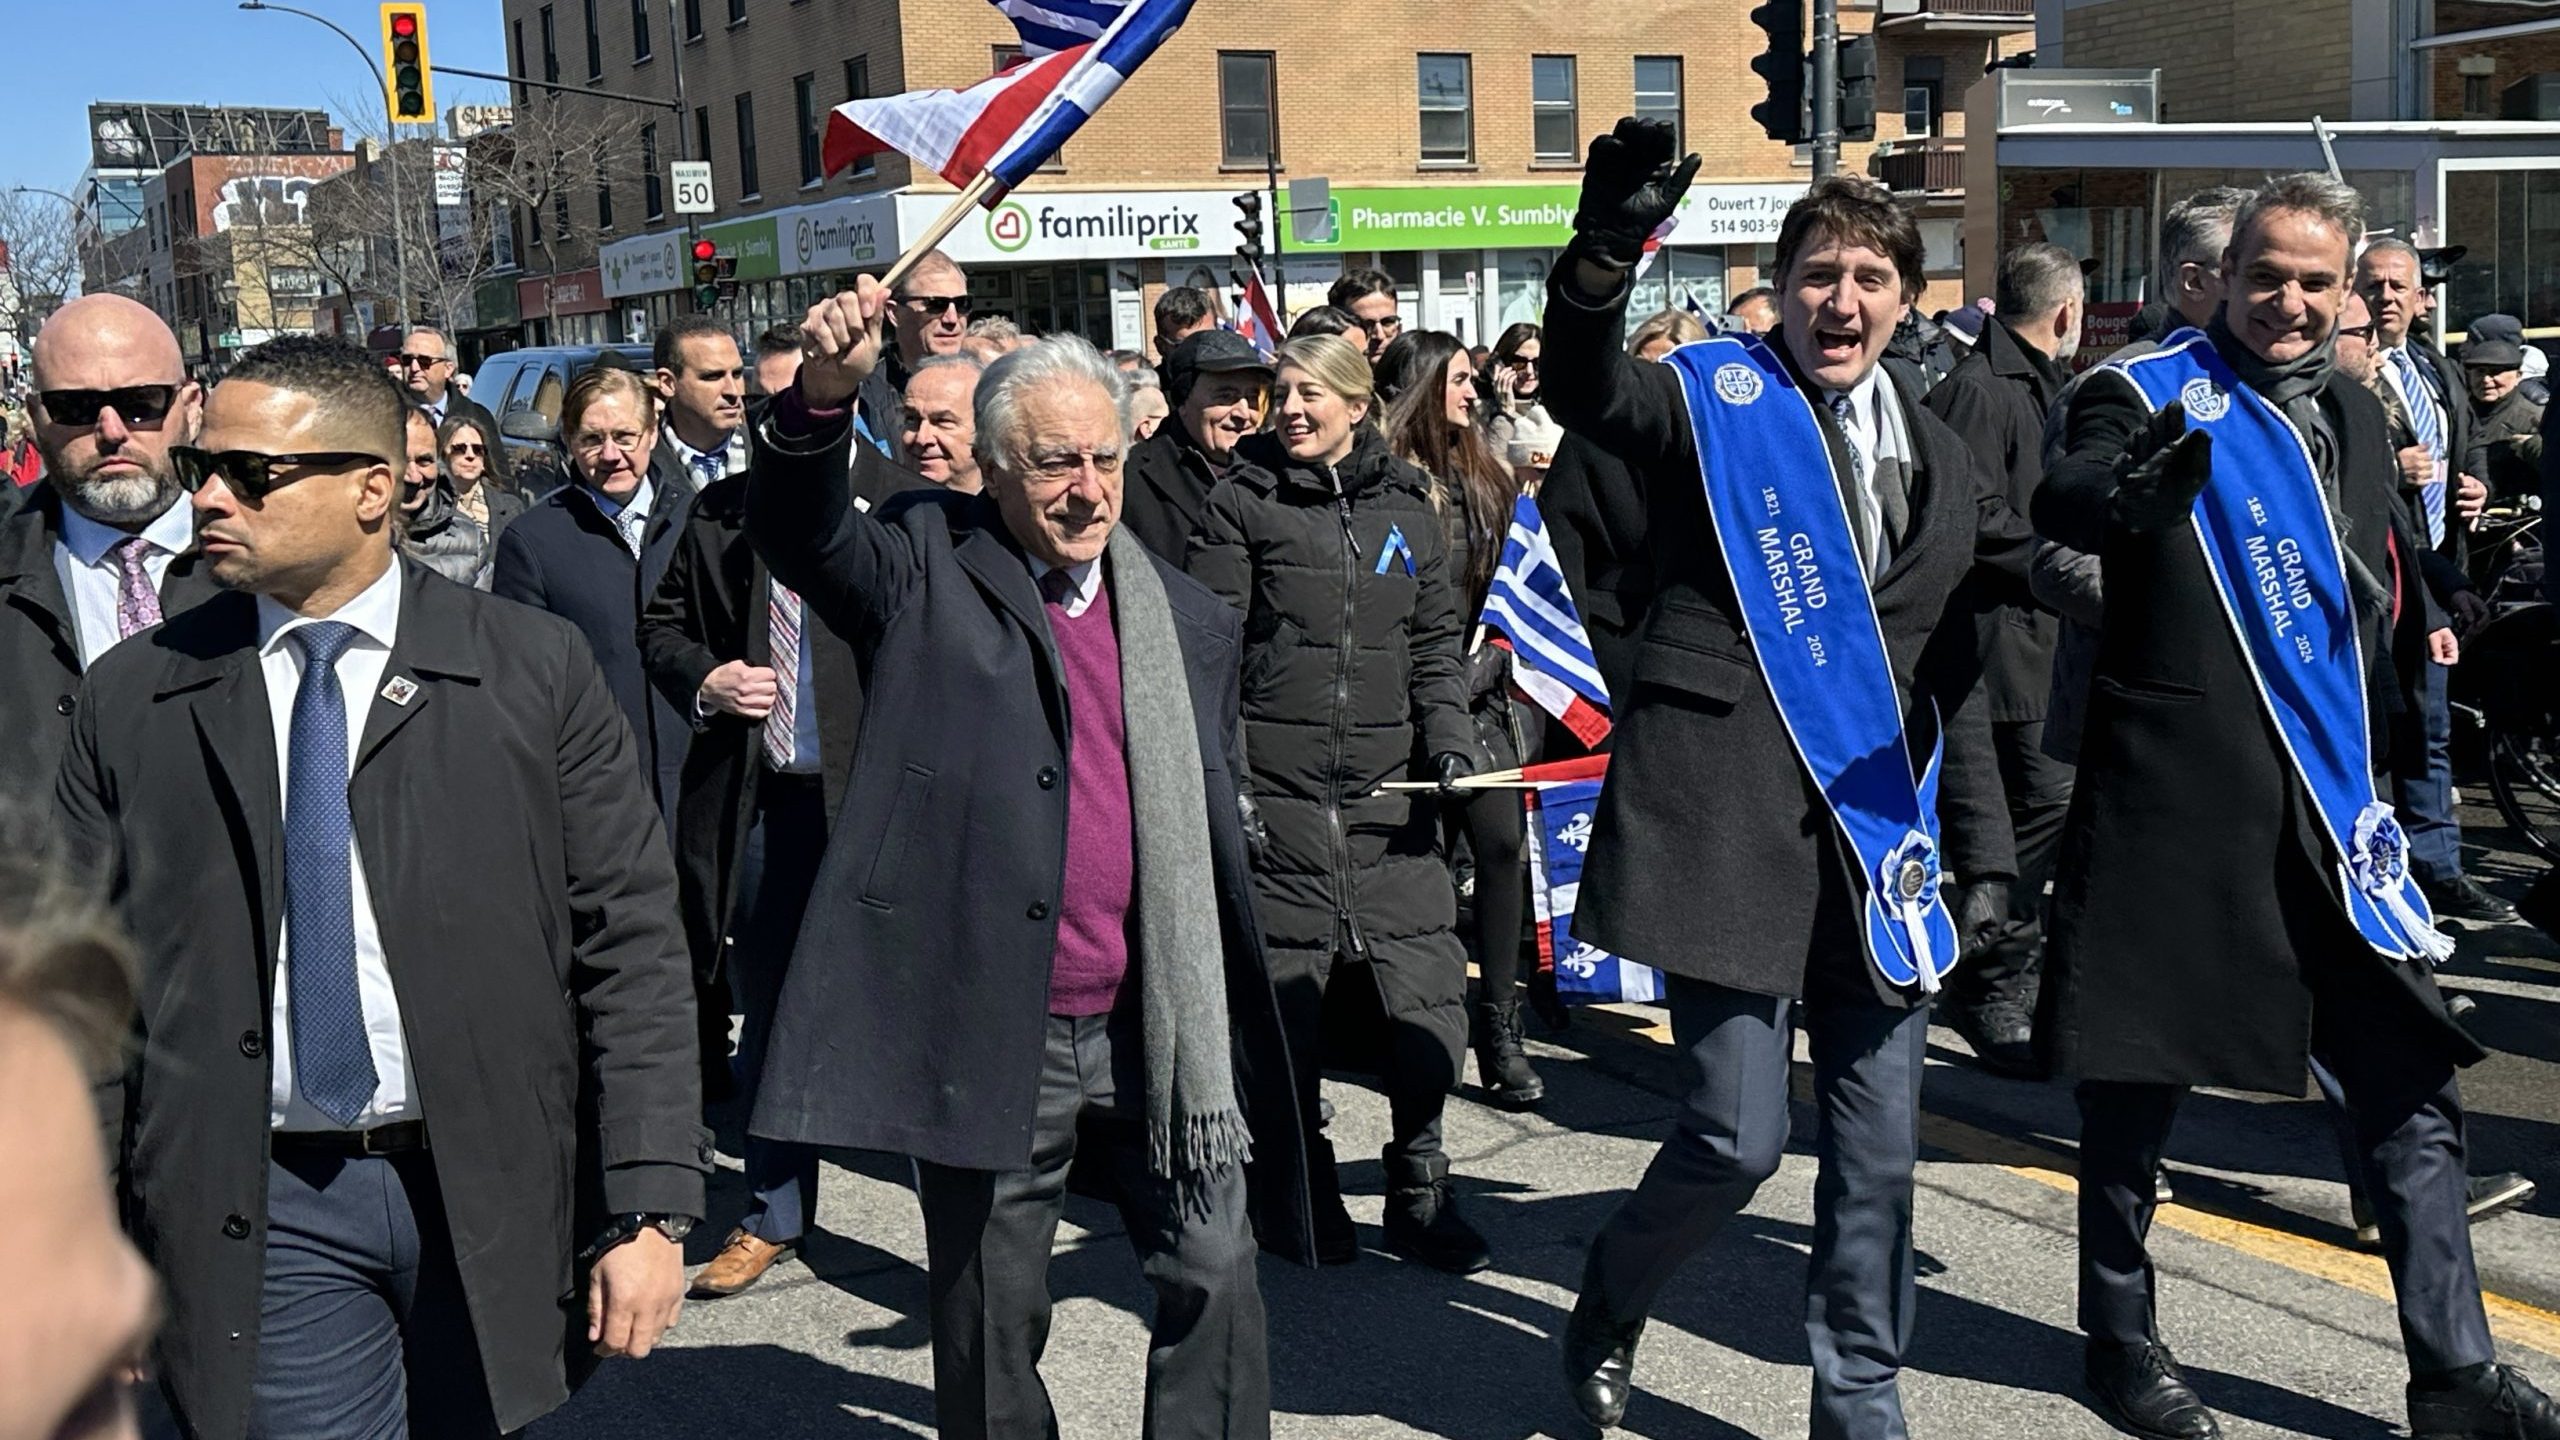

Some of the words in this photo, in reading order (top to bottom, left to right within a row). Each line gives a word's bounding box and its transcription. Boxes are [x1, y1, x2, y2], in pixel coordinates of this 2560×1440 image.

[675, 169, 708, 178] MAXIMUM
[679, 182, 708, 204] 50
[1708, 197, 1754, 210] Ouvert
[1759, 196, 1767, 210] 7
[1039, 204, 1199, 246] familiprix
[1352, 206, 1466, 229] Pharmacie
[1471, 205, 1491, 227] V.
[1498, 204, 1575, 229] Sumbly
[1711, 220, 1735, 233] 514
[1740, 219, 1784, 233] 903-9
[814, 216, 875, 256] familiprix
[1159, 238, 1190, 249] SANTÉ
[2089, 332, 2097, 346] à
[2100, 332, 2128, 345] votr
[1762, 486, 1781, 518] 1821
[2247, 496, 2268, 527] 1821
[1757, 527, 1806, 635] MARSHAL
[1789, 532, 1827, 610] GRAND
[2246, 535, 2293, 638] MARSHAL
[2277, 537, 2311, 610] GRAND
[1806, 635, 1828, 667] 2024
[2295, 634, 2315, 663] 2024
